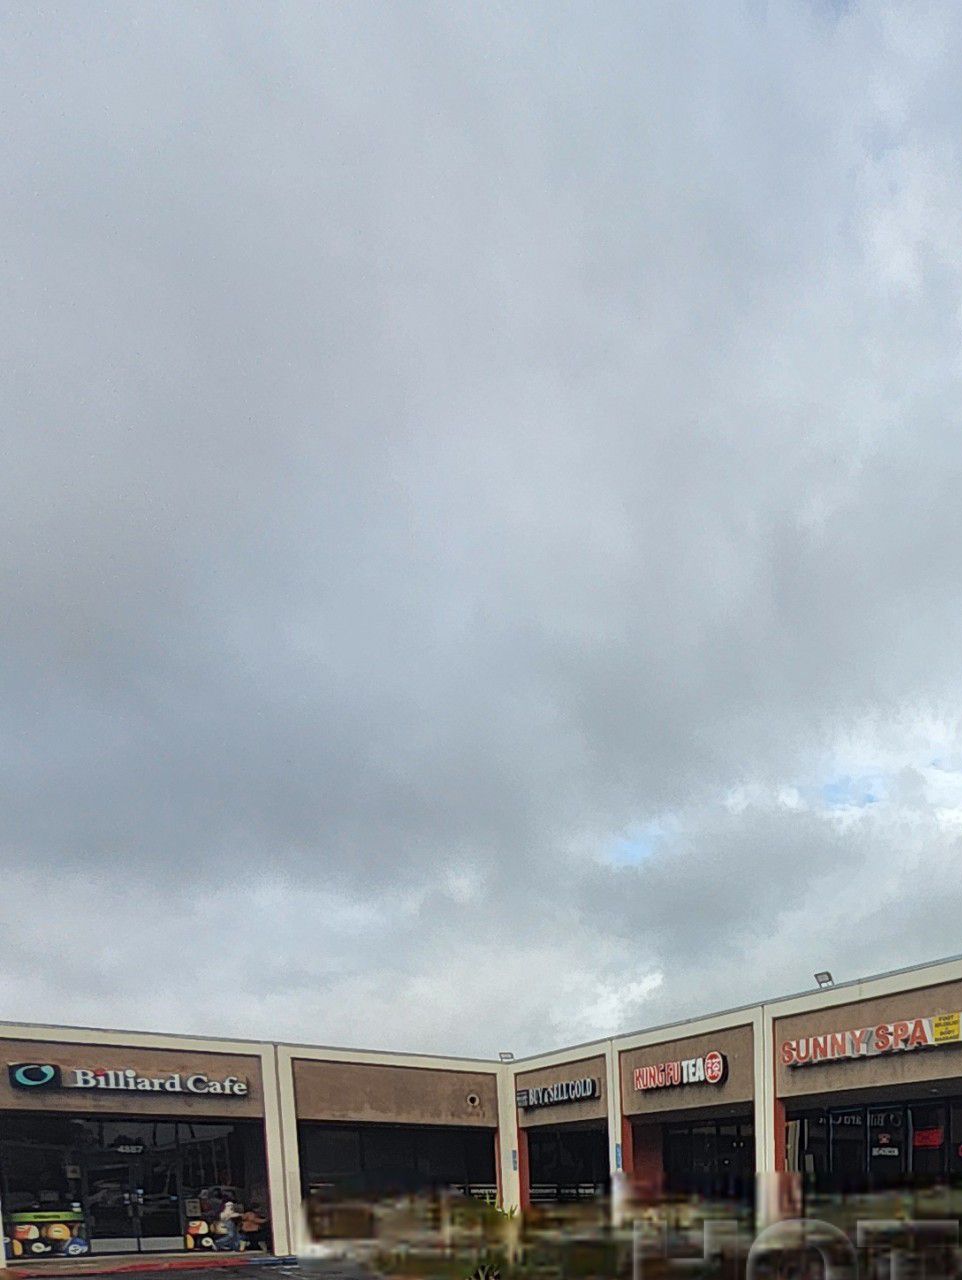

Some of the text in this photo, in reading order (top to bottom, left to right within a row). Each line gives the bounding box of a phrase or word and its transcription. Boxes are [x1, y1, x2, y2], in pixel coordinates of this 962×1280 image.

[781, 1018, 929, 1066] SUNNY SPA
[73, 1068, 248, 1096] Billiard Cafe
[633, 1063, 665, 1091] KUNG
[665, 1060, 681, 1086] FU
[681, 1057, 705, 1085] TEA
[528, 1086, 545, 1106] BUY
[549, 1081, 569, 1101] SELL
[568, 1077, 593, 1099] GOLD
